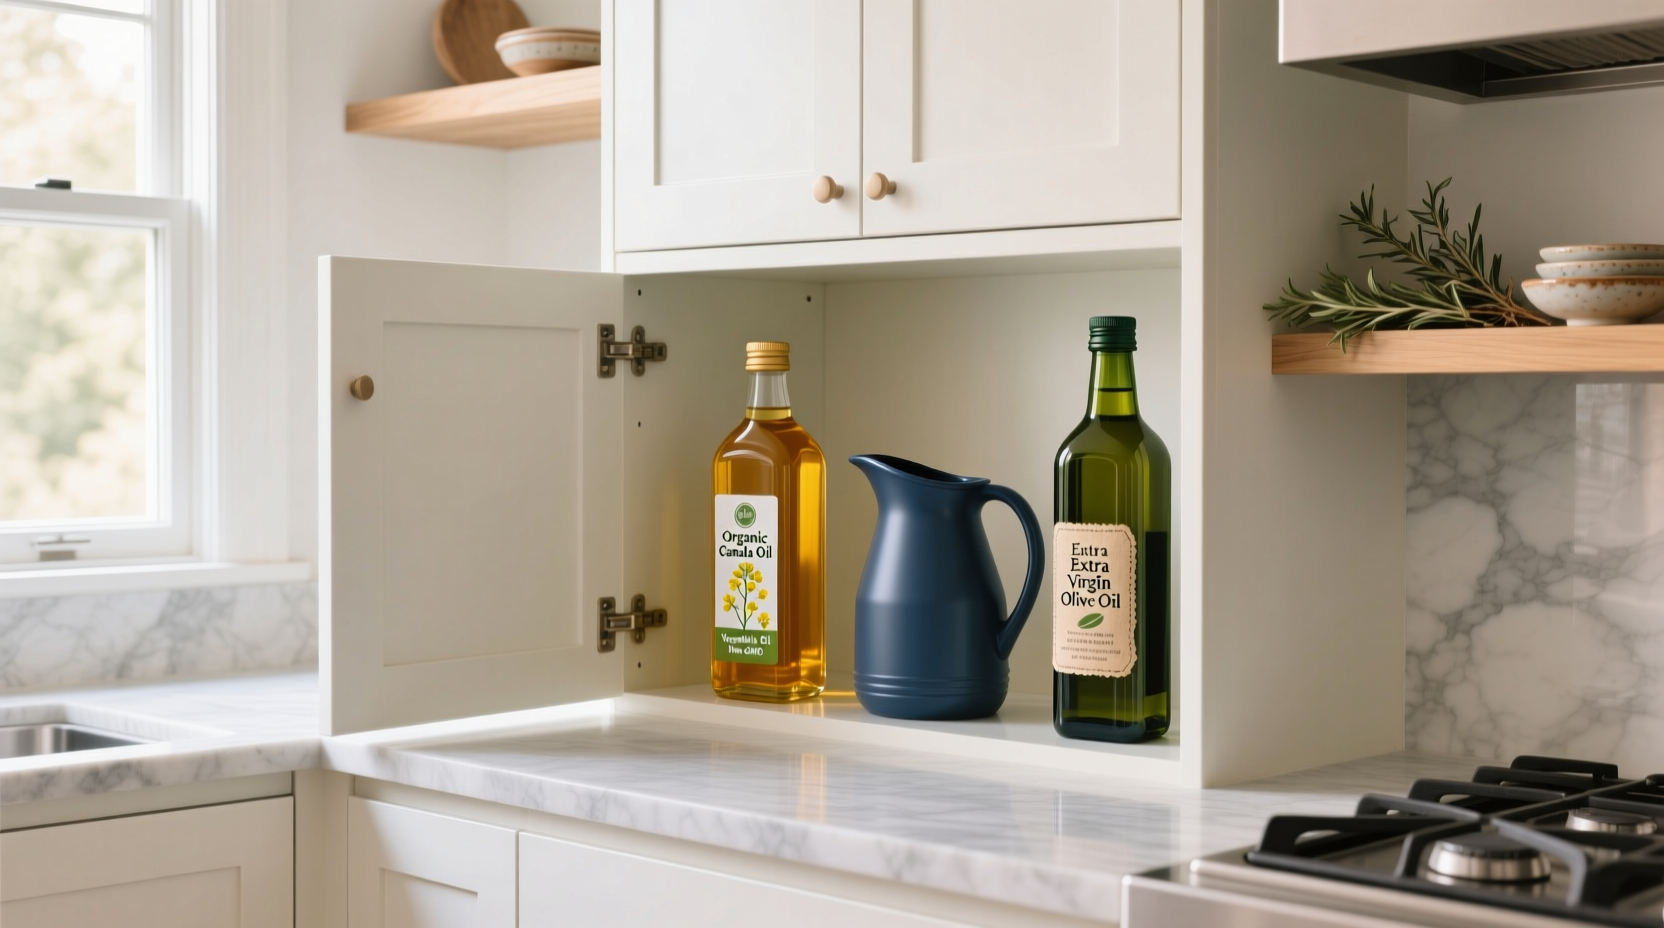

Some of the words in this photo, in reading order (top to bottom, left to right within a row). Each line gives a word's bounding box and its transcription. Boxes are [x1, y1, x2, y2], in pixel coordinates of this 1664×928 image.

[722, 530, 768, 546] Organic
[756, 545, 772, 559] Oil
[1070, 557, 1110, 573] Extra
[1067, 574, 1111, 594] Virgin
[1061, 591, 1095, 607] Olive
[1098, 593, 1121, 609] Oil
